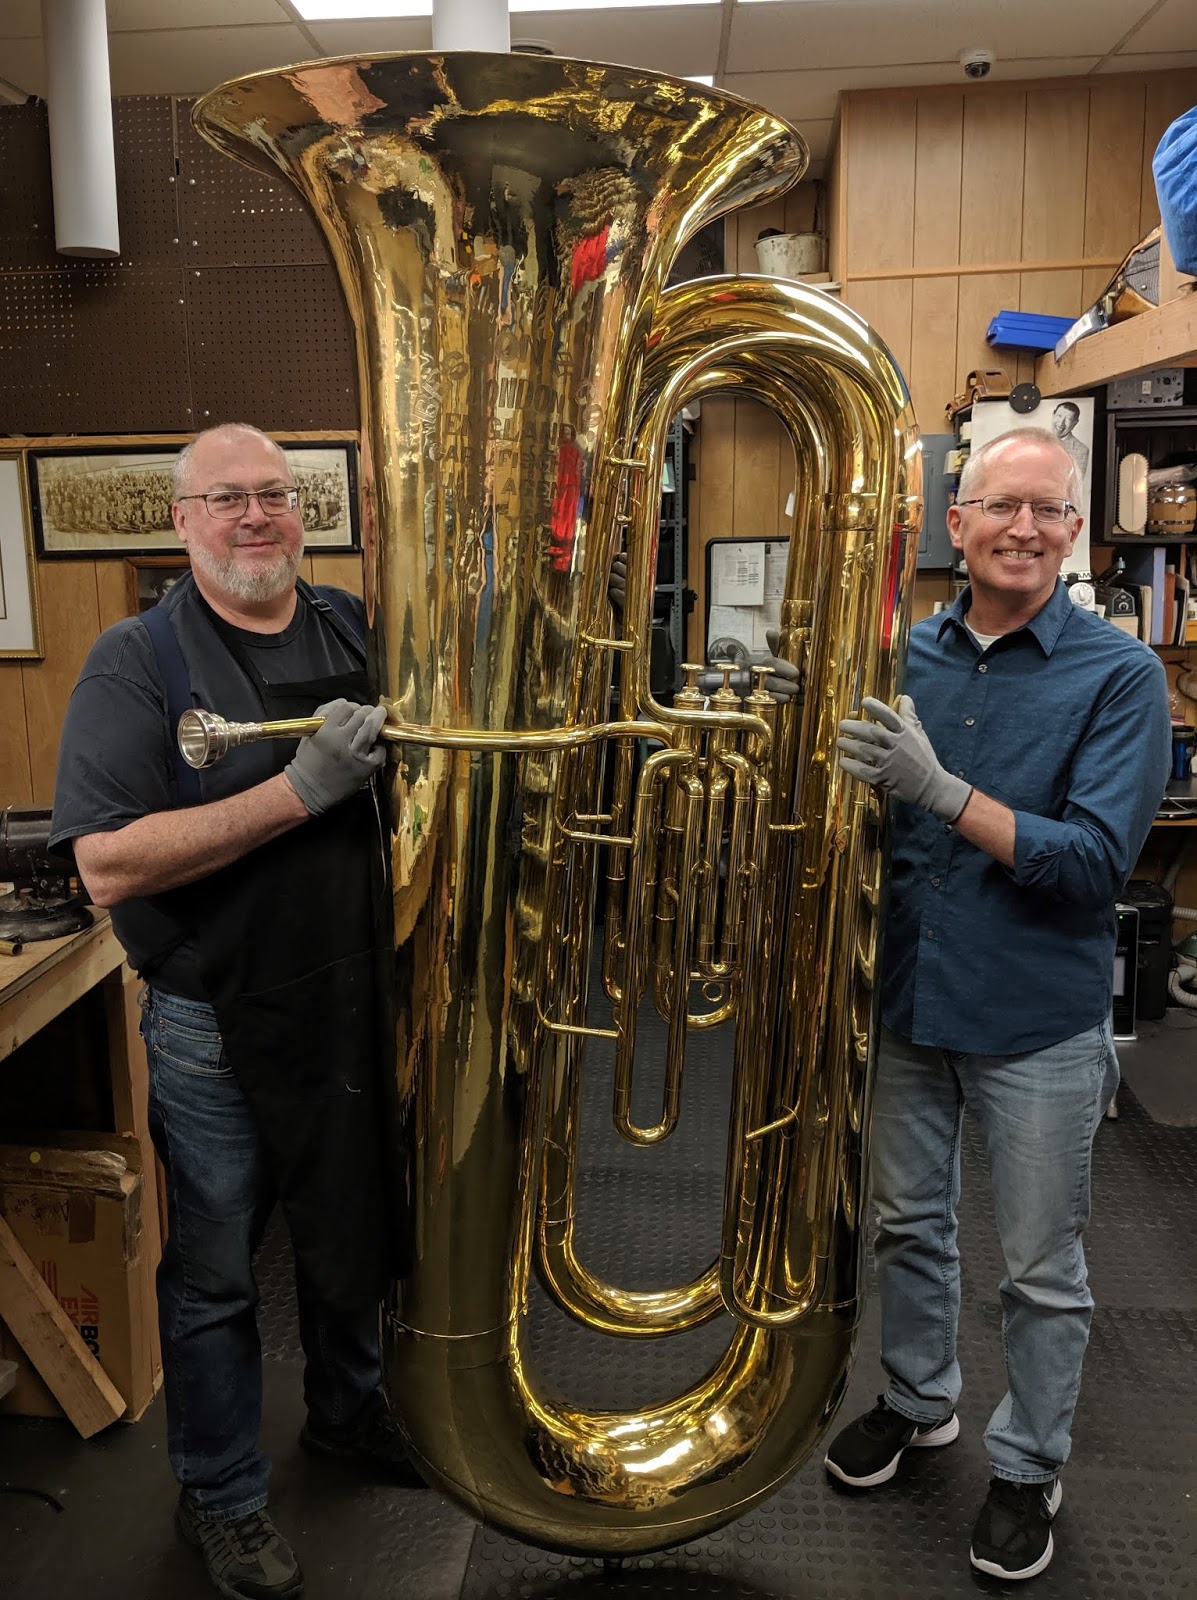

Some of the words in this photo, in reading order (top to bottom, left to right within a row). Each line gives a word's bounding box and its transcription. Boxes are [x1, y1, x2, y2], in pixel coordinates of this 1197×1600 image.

[412, 332, 543, 423] BESON
[446, 413, 577, 446] ENGLAND
[61, 1297, 79, 1334] EX
